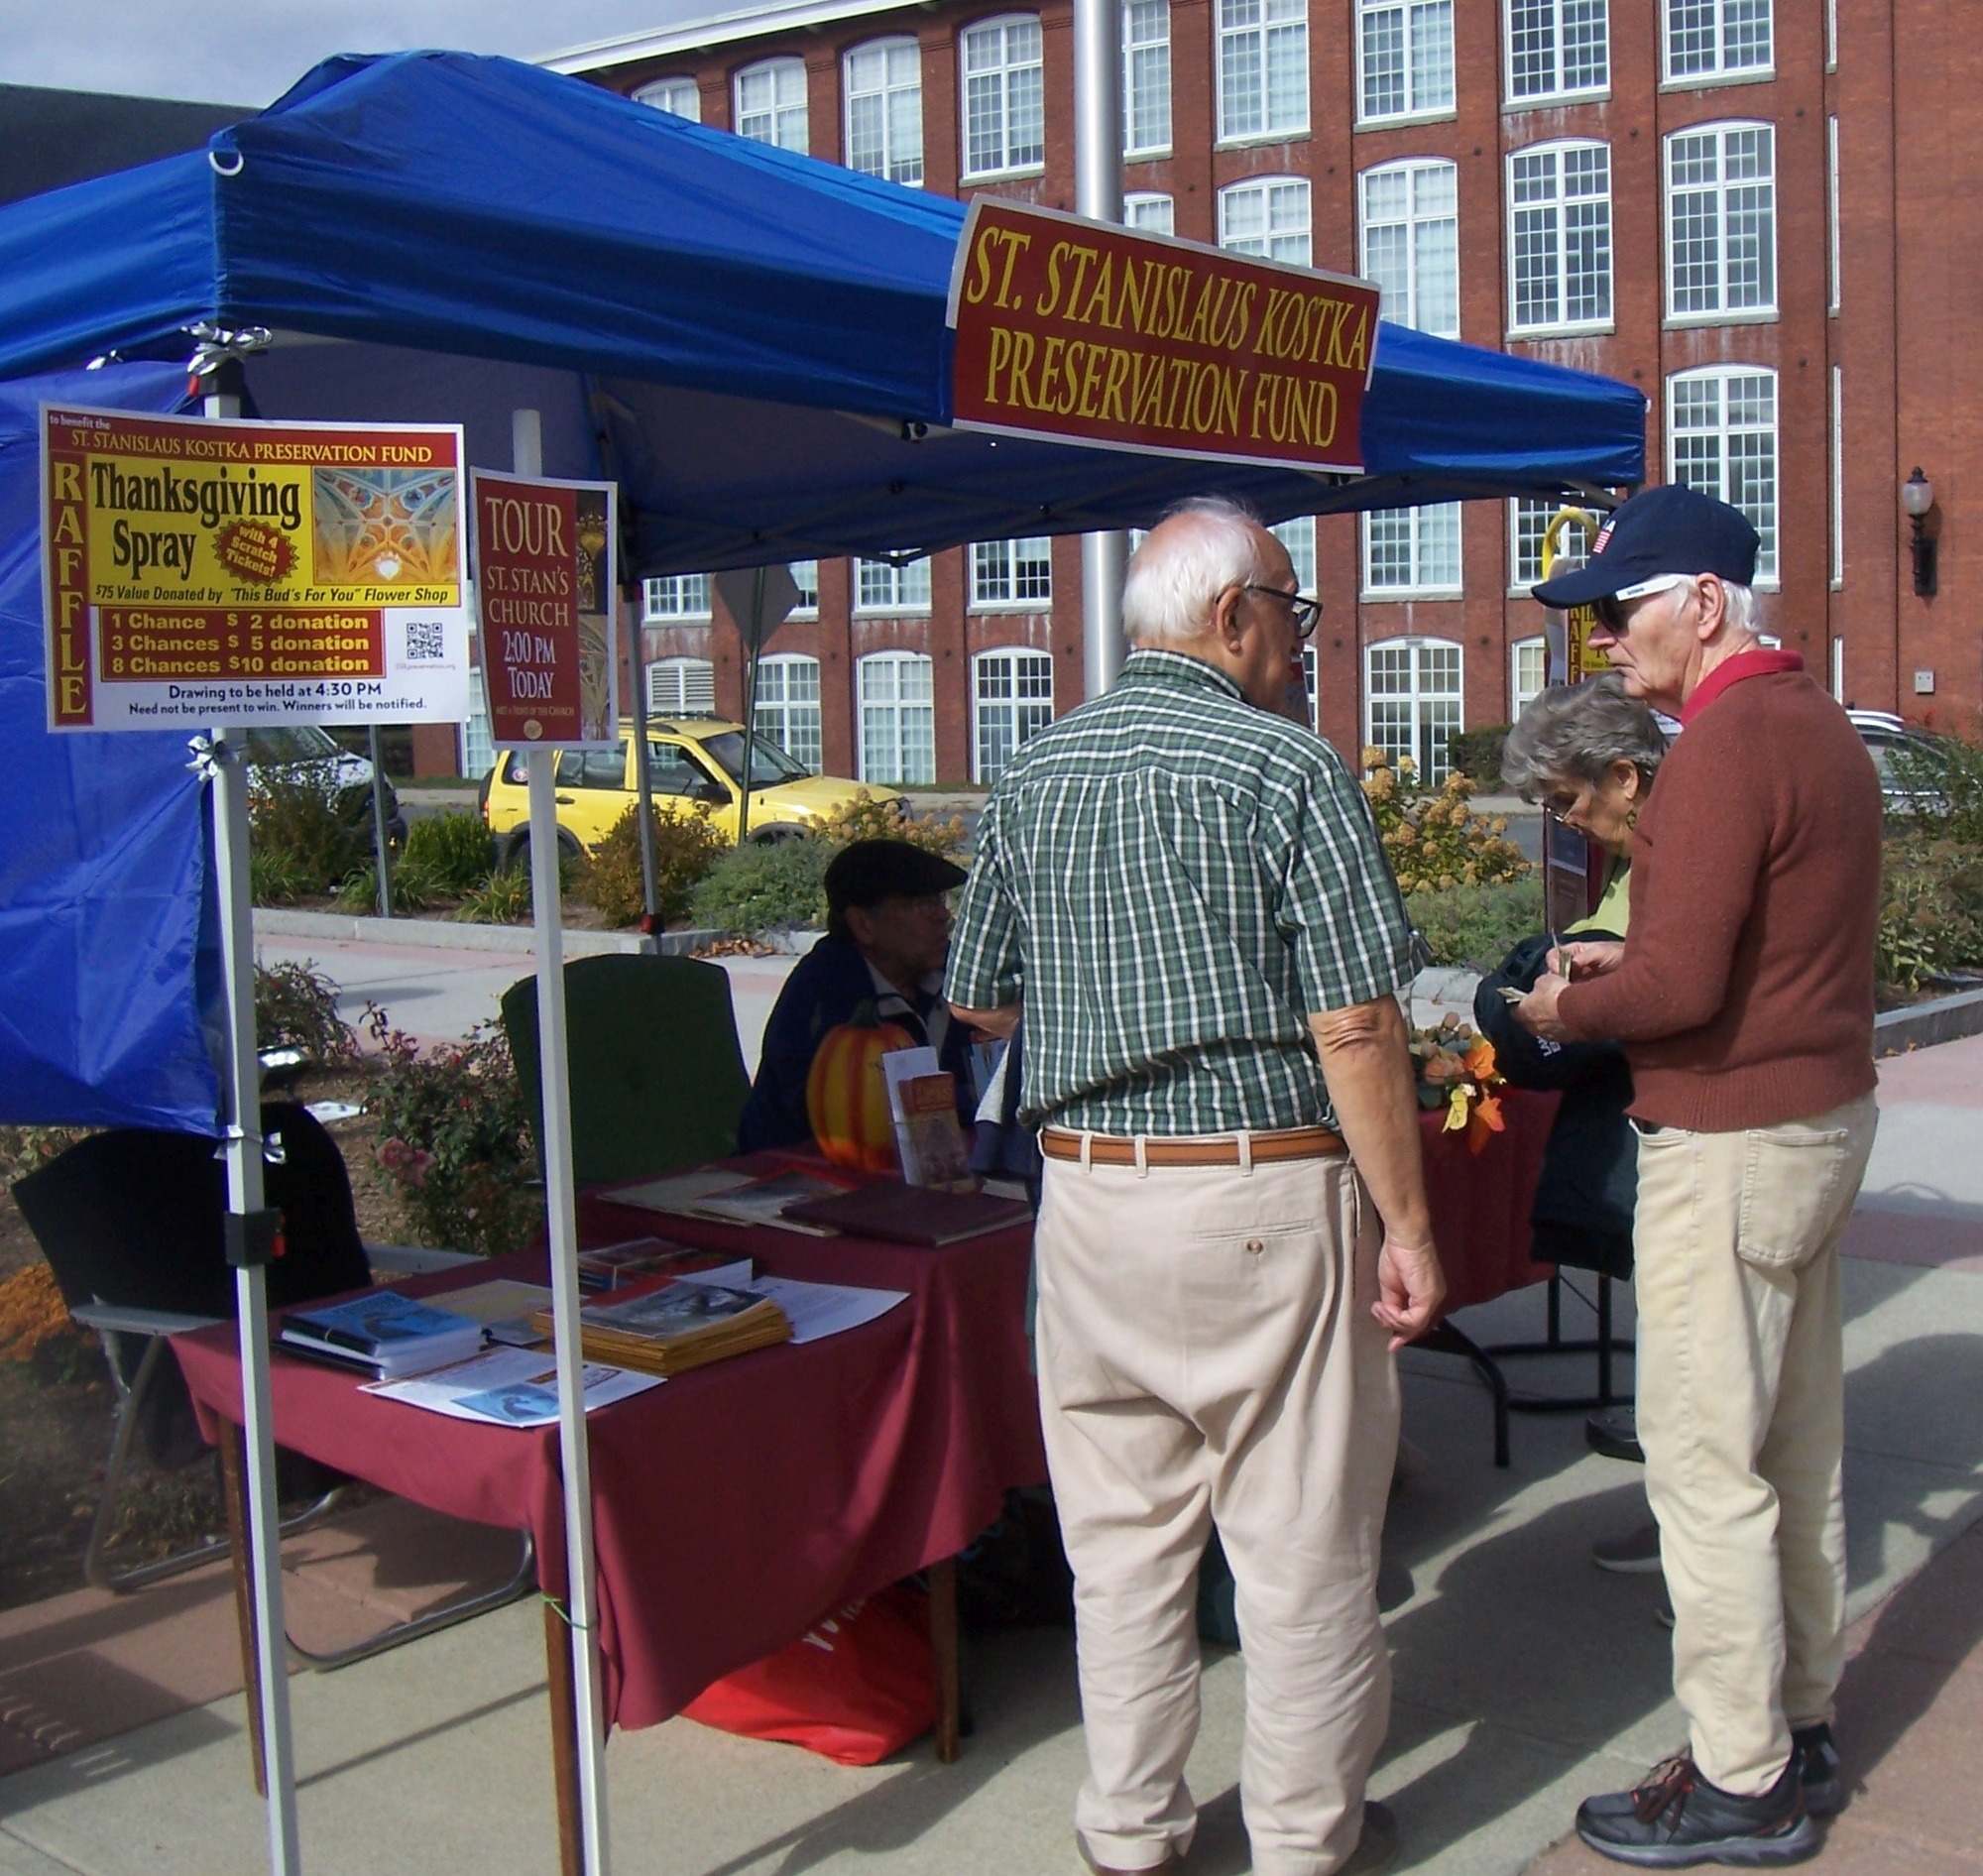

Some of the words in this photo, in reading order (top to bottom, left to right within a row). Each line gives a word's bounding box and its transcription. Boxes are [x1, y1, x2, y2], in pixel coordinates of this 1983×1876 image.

[966, 226, 1032, 310] ST.
[1036, 241, 1258, 351] STANISLAUS
[1252, 288, 1367, 372] KOSTKA
[984, 326, 1249, 438] PRESERVATION
[1249, 373, 1338, 447] FUND
[50, 414, 60, 425] to
[60, 414, 94, 428] benefit
[95, 417, 111, 430] the
[71, 429, 91, 447] ST.
[93, 431, 181, 455] STANISLAUS
[185, 439, 250, 459] KOSTKA
[254, 443, 377, 462] PRESERVATION
[381, 446, 432, 463] FUND
[91, 462, 301, 529] Thanksgiving
[239, 526, 267, 545] with
[268, 535, 279, 549] 4
[485, 497, 569, 557] TOUR
[112, 519, 197, 581] Spray
[225, 547, 276, 578] Tickets!
[230, 535, 278, 565] Scratch
[54, 462, 87, 714] RAFFLE
[95, 583, 114, 600] $75
[117, 585, 149, 600] Value
[153, 587, 204, 602] Donated
[207, 587, 223, 604] by
[304, 588, 325, 602] For
[364, 589, 411, 601] Flower
[414, 588, 448, 603] Shop
[487, 566, 509, 592] ST.
[111, 612, 121, 630] 1
[128, 612, 206, 630] Chance
[226, 613, 239, 628] $
[250, 614, 264, 631] 2
[269, 613, 369, 631] donation
[488, 599, 569, 628] CHURCH
[111, 635, 124, 651] 3
[129, 635, 220, 652] Chances
[227, 635, 240, 648] $
[250, 635, 264, 651] 5
[270, 636, 370, 651] donation
[503, 631, 532, 664] 2:00
[534, 637, 556, 664] PM
[112, 656, 125, 674] 8
[130, 656, 221, 674] Chances
[228, 655, 265, 673] $10
[270, 656, 370, 673] donation
[129, 702, 159, 715] Need
[160, 703, 179, 714] not
[181, 701, 196, 714] be
[198, 703, 241, 716] present
[243, 703, 256, 713] to
[257, 701, 281, 713] win.
[283, 699, 333, 711] Winners
[335, 698, 356, 710] will
[358, 699, 374, 710] be
[376, 697, 427, 710] notified.
[169, 684, 226, 702] Drawing
[229, 686, 244, 698] to
[246, 684, 263, 697] be
[265, 683, 294, 698] held
[297, 685, 312, 696] at
[314, 682, 353, 696] 4:30
[356, 682, 383, 696] PM
